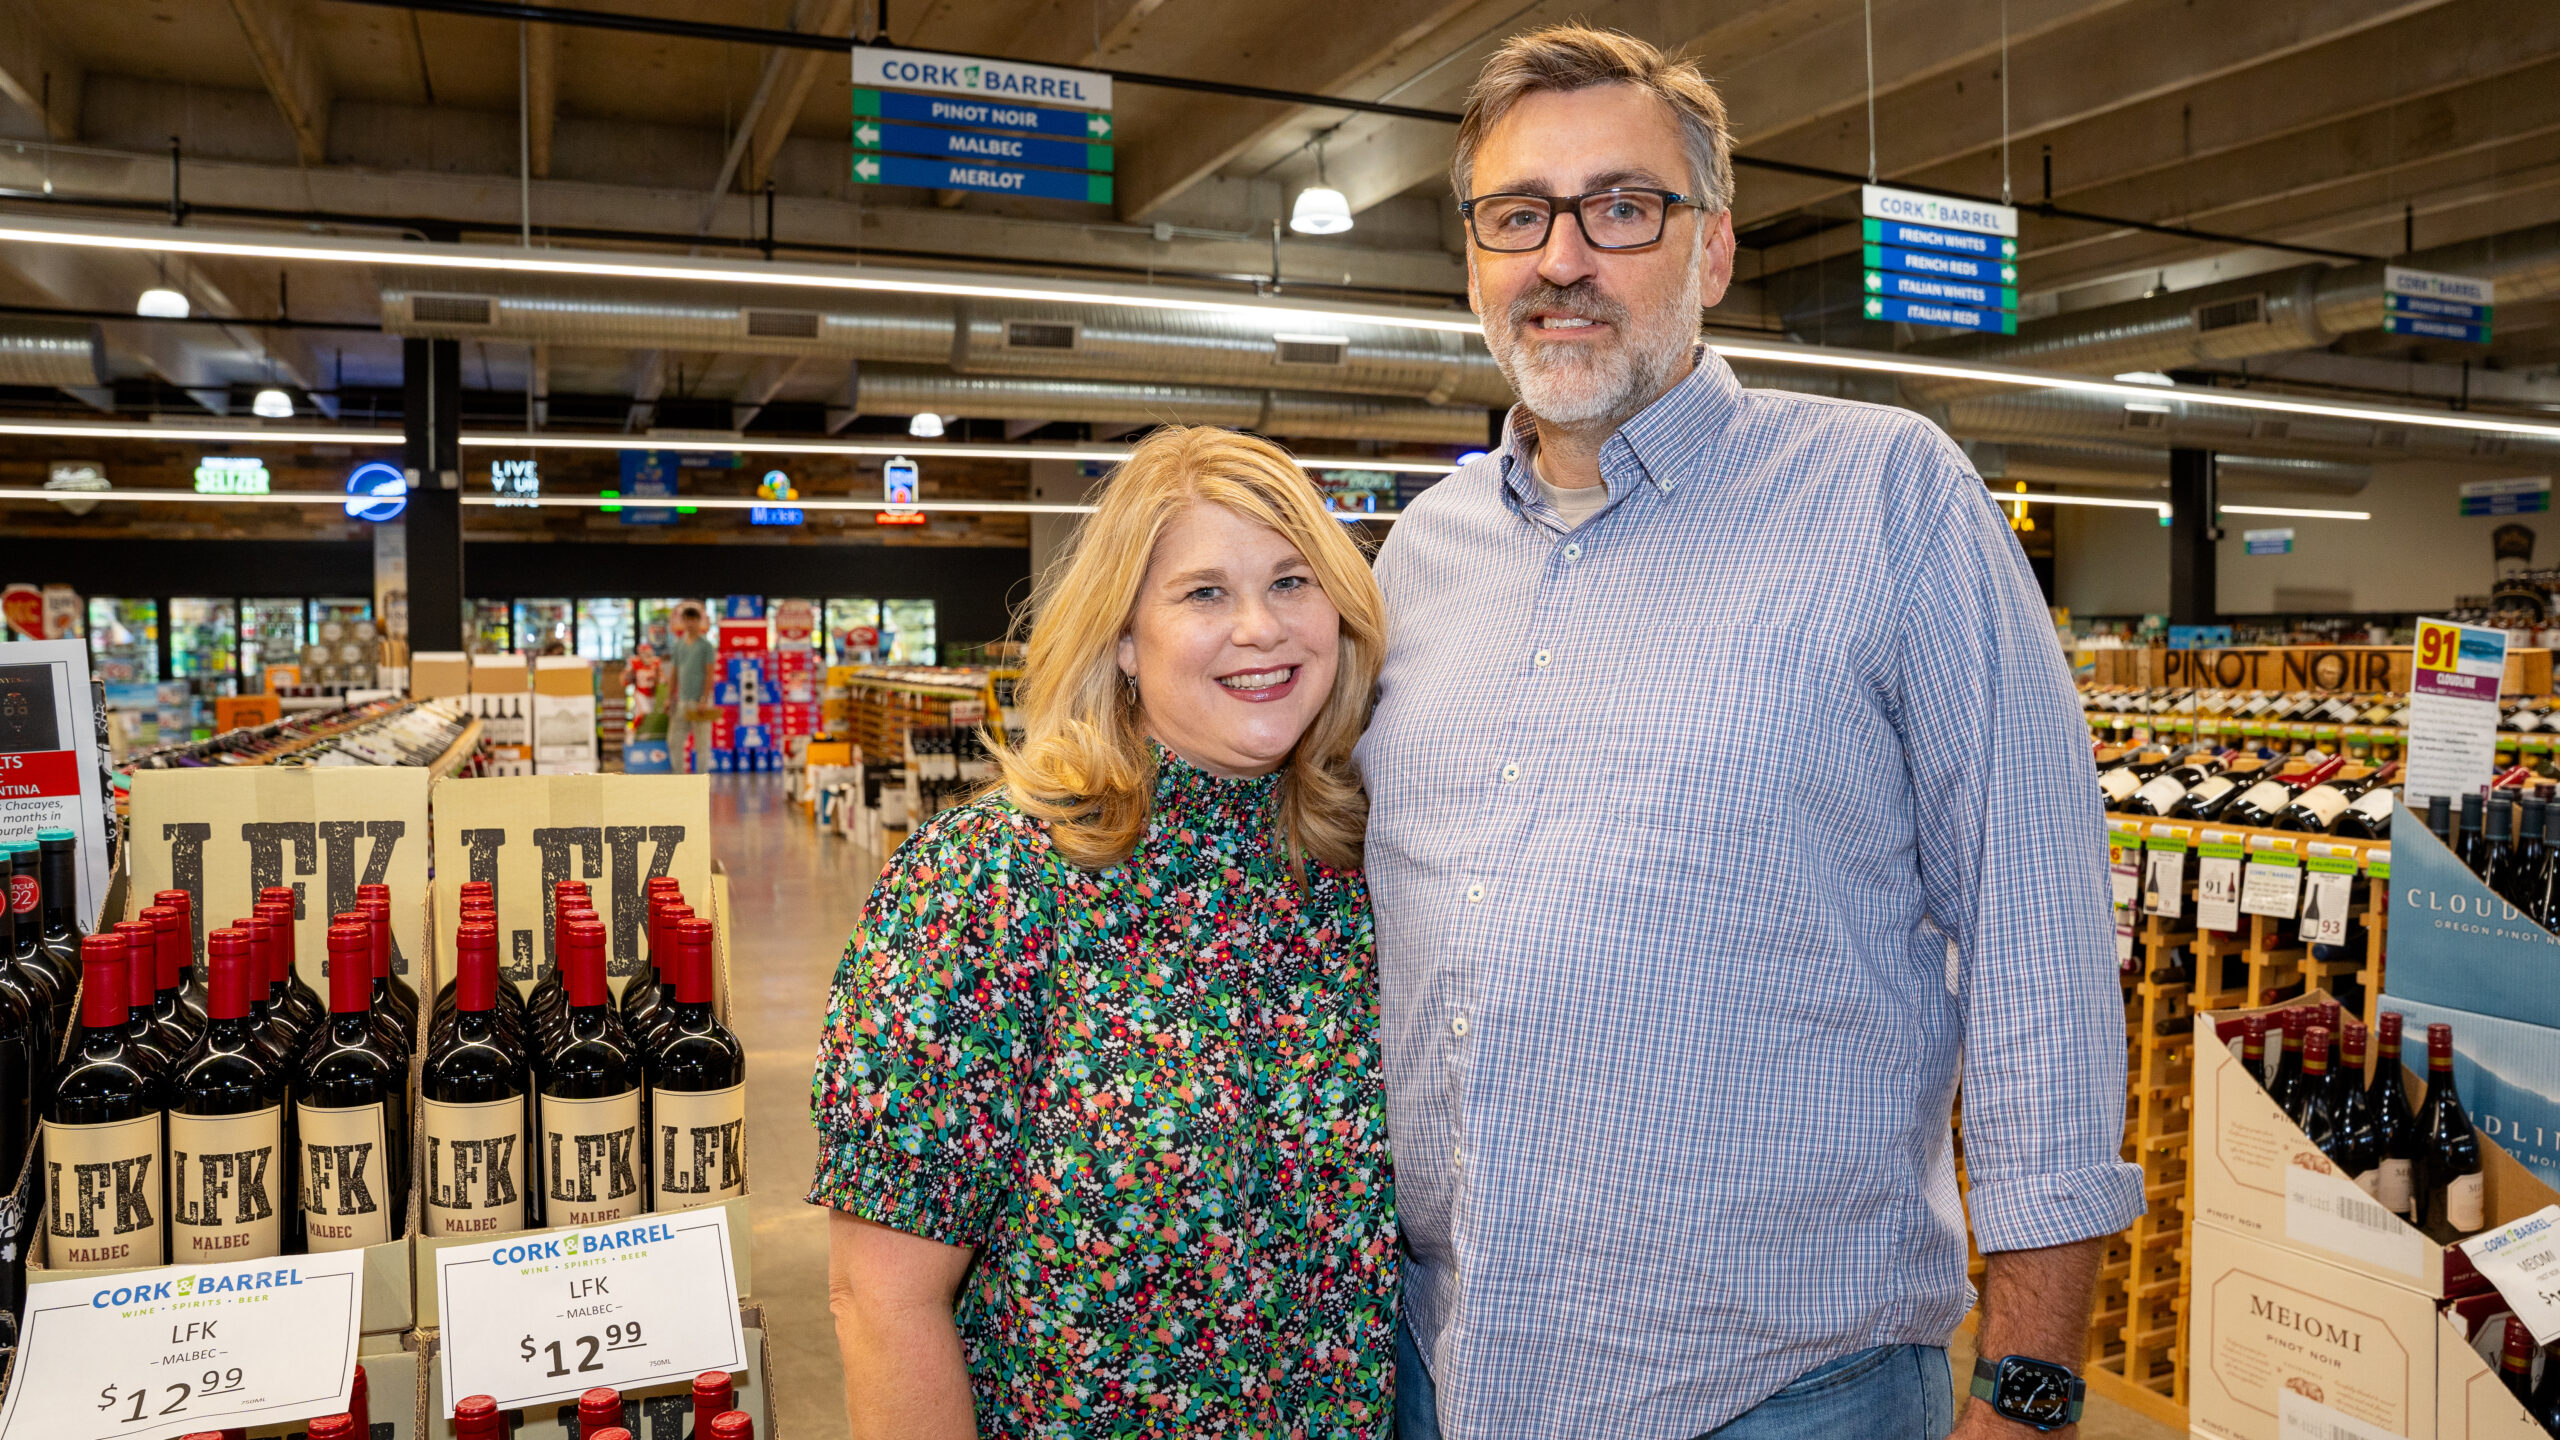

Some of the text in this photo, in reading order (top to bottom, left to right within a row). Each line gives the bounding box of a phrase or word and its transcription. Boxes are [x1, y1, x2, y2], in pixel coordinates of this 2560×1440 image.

[882, 60, 959, 86] CORK
[984, 71, 1087, 101] BARREL
[932, 102, 1039, 127] PINOT NOIR
[949, 135, 1023, 157] MALBEC
[949, 167, 1025, 189] MERLOT
[1880, 197, 2000, 230] CORK BARREL
[1899, 227, 1987, 252] FRENCH WHITES
[1905, 254, 1979, 277] FRENCH REDS
[1898, 279, 1986, 302] ITALIAN WHITES
[1907, 304, 1981, 327] ITALIAN REDS
[194, 467, 270, 495] SELTZER
[491, 460, 538, 478] LIVE
[2421, 626, 2456, 669] 91
[2163, 650, 2391, 691] PINOT NOIR
[2436, 672, 2477, 690] CLOUDLINE
[3, 810, 61, 824] months in
[5, 799, 64, 812] Chacayes,
[2205, 880, 2222, 895] 91
[2321, 919, 2341, 934] 93
[2434, 919, 2490, 935] OREGON
[2496, 928, 2540, 943] PINOT
[548, 1125, 638, 1203] LFK
[660, 1117, 742, 1194] LFK
[427, 1132, 518, 1210] LFK
[48, 1153, 155, 1239] LFK
[174, 1145, 273, 1227] LFK
[445, 1216, 498, 1233] MALBEC
[569, 1208, 622, 1225] MALBEC
[2206, 1207, 2262, 1230] PINOT NOIR
[192, 1232, 250, 1251] MALBEC
[309, 1221, 353, 1239] MALBEC
[2484, 1233, 2513, 1253] CORK
[2512, 1218, 2552, 1241] BARREL
[68, 1243, 129, 1263] MALBEC
[492, 1240, 561, 1266] CORK
[583, 1223, 675, 1253] BARREL
[520, 1250, 648, 1277] WINE SPIRITS BEER
[92, 1281, 172, 1309] CORK
[197, 1268, 304, 1294] BARREL
[570, 1275, 609, 1299] LFK
[121, 1294, 270, 1319] WINE SPIRITS BEER
[566, 1303, 614, 1319] MALBEC
[172, 1320, 218, 1344] LFK
[2250, 1294, 2363, 1354] MEIOMI
[162, 1348, 217, 1366] MALBEC
[648, 1358, 672, 1367] 750ML
[2266, 1334, 2343, 1369] PINOT NOIR
